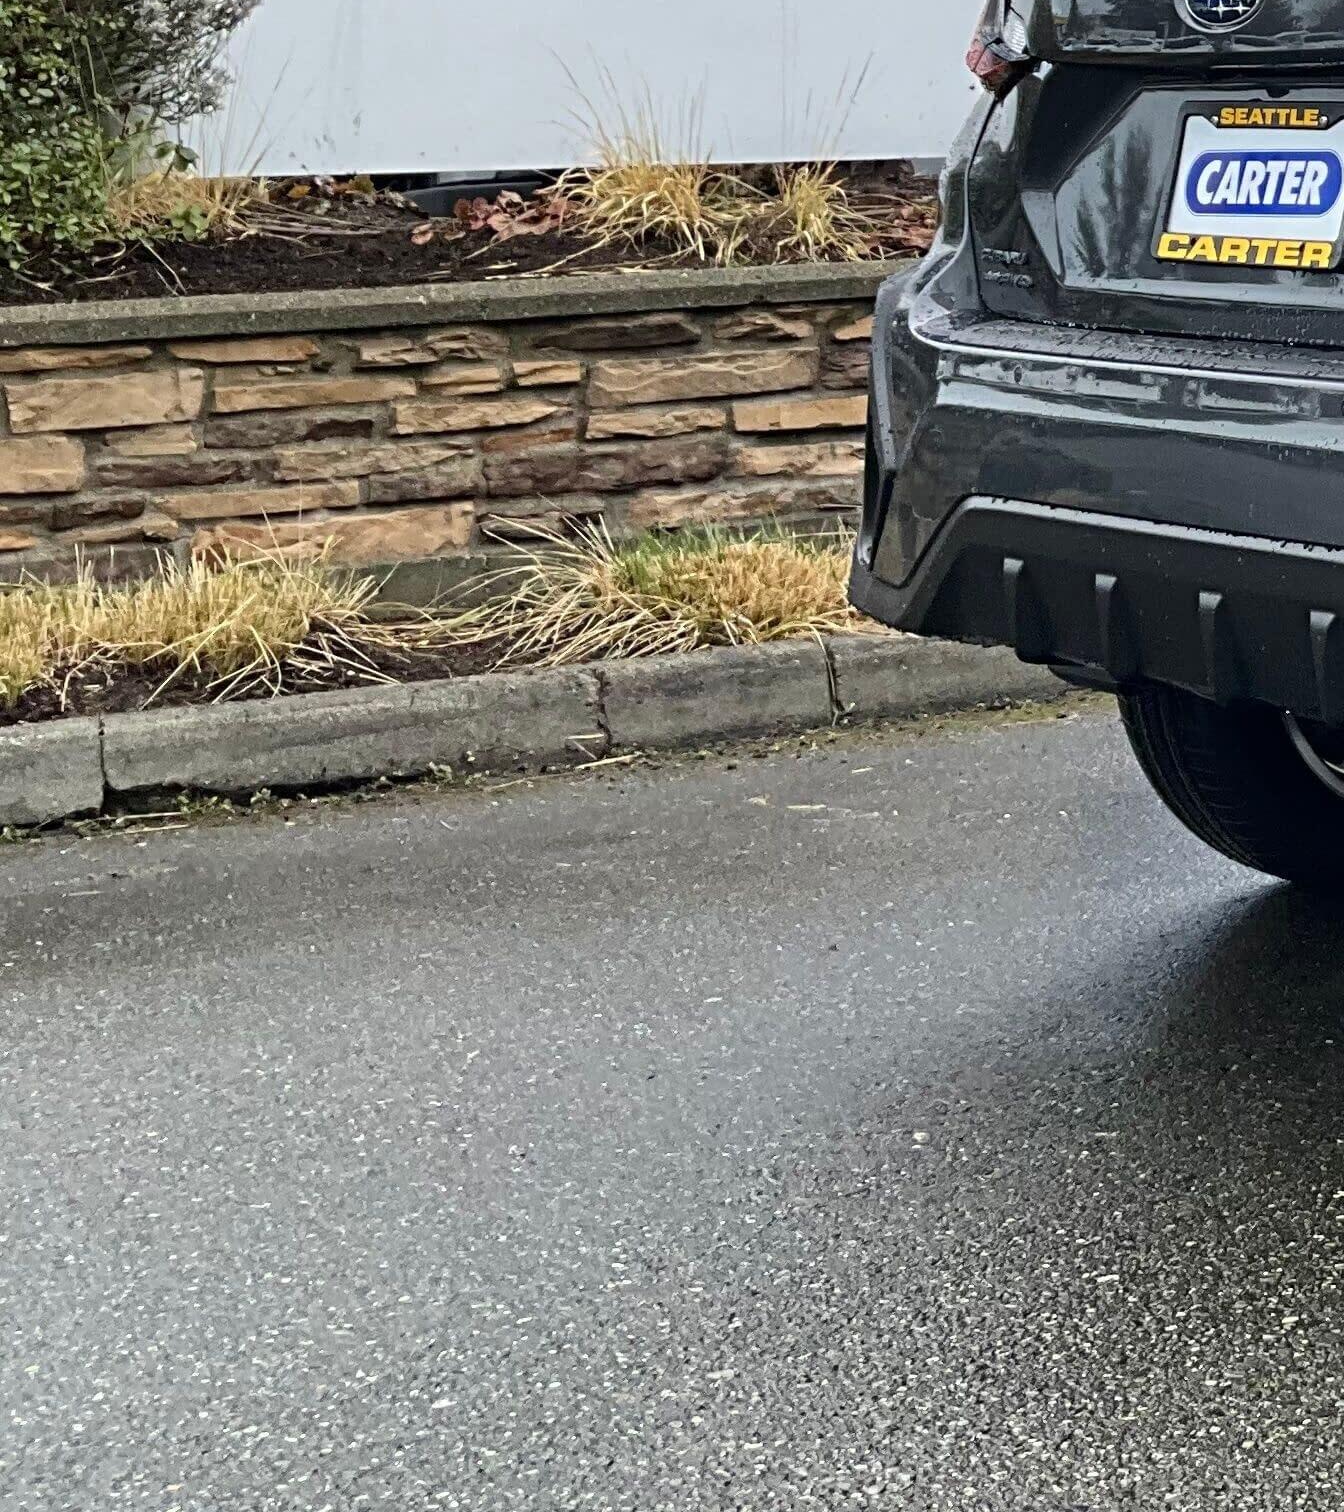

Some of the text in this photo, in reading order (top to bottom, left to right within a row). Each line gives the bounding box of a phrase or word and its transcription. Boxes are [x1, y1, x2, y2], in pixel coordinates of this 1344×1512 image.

[1217, 107, 1320, 127] SEATTLE
[1195, 159, 1329, 206] CARTER
[1156, 232, 1333, 269] CARTER
